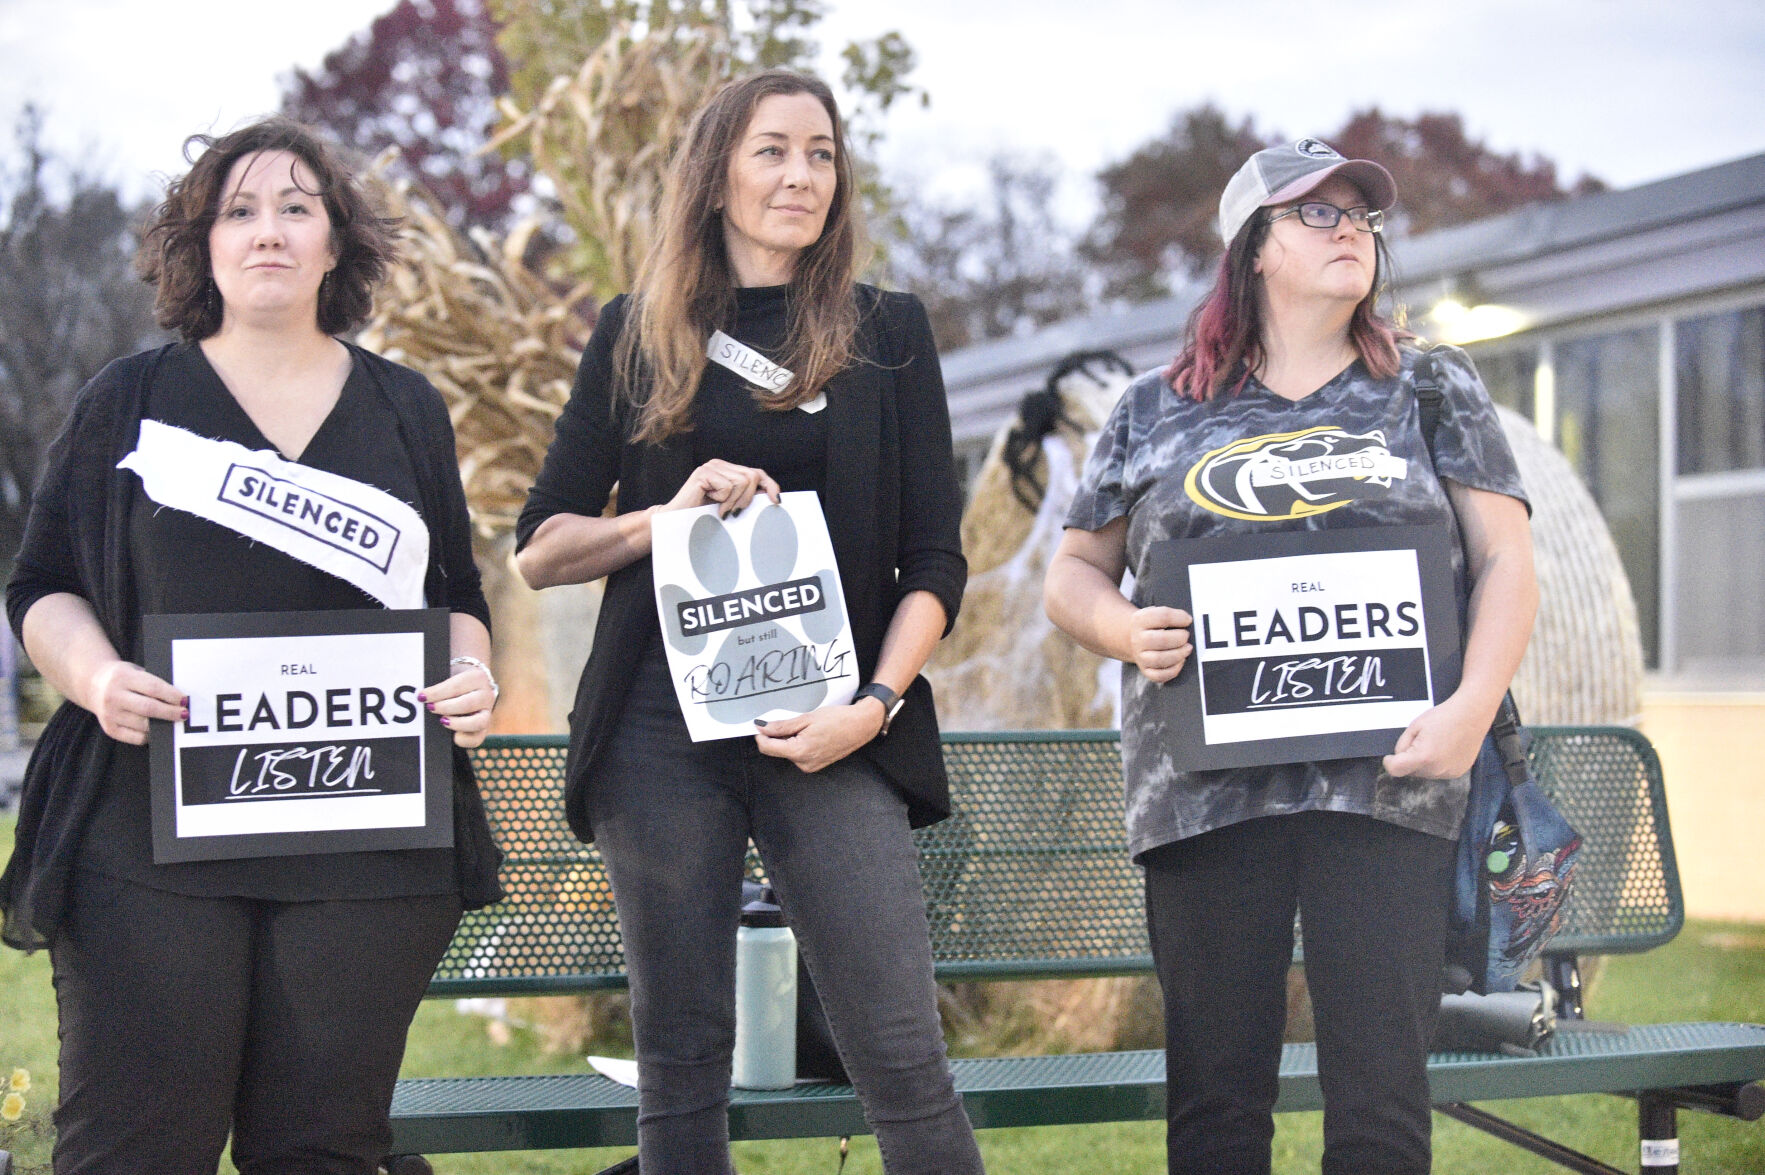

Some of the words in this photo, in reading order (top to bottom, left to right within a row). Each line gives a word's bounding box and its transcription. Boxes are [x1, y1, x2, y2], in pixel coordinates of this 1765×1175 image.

[720, 343, 789, 387] SILENC
[1270, 456, 1375, 480] SILENCED
[238, 476, 380, 550] SILENCED
[682, 584, 820, 630] SILENCED
[1291, 581, 1325, 593] REAL
[737, 635, 756, 646] but
[759, 628, 778, 642] still
[1202, 601, 1420, 650] LEADERS
[280, 664, 318, 676] REAL
[684, 638, 851, 699] ROARING
[1250, 655, 1386, 704] LISTEN
[183, 685, 418, 734] LEADERS
[230, 745, 376, 795] LISTEN
